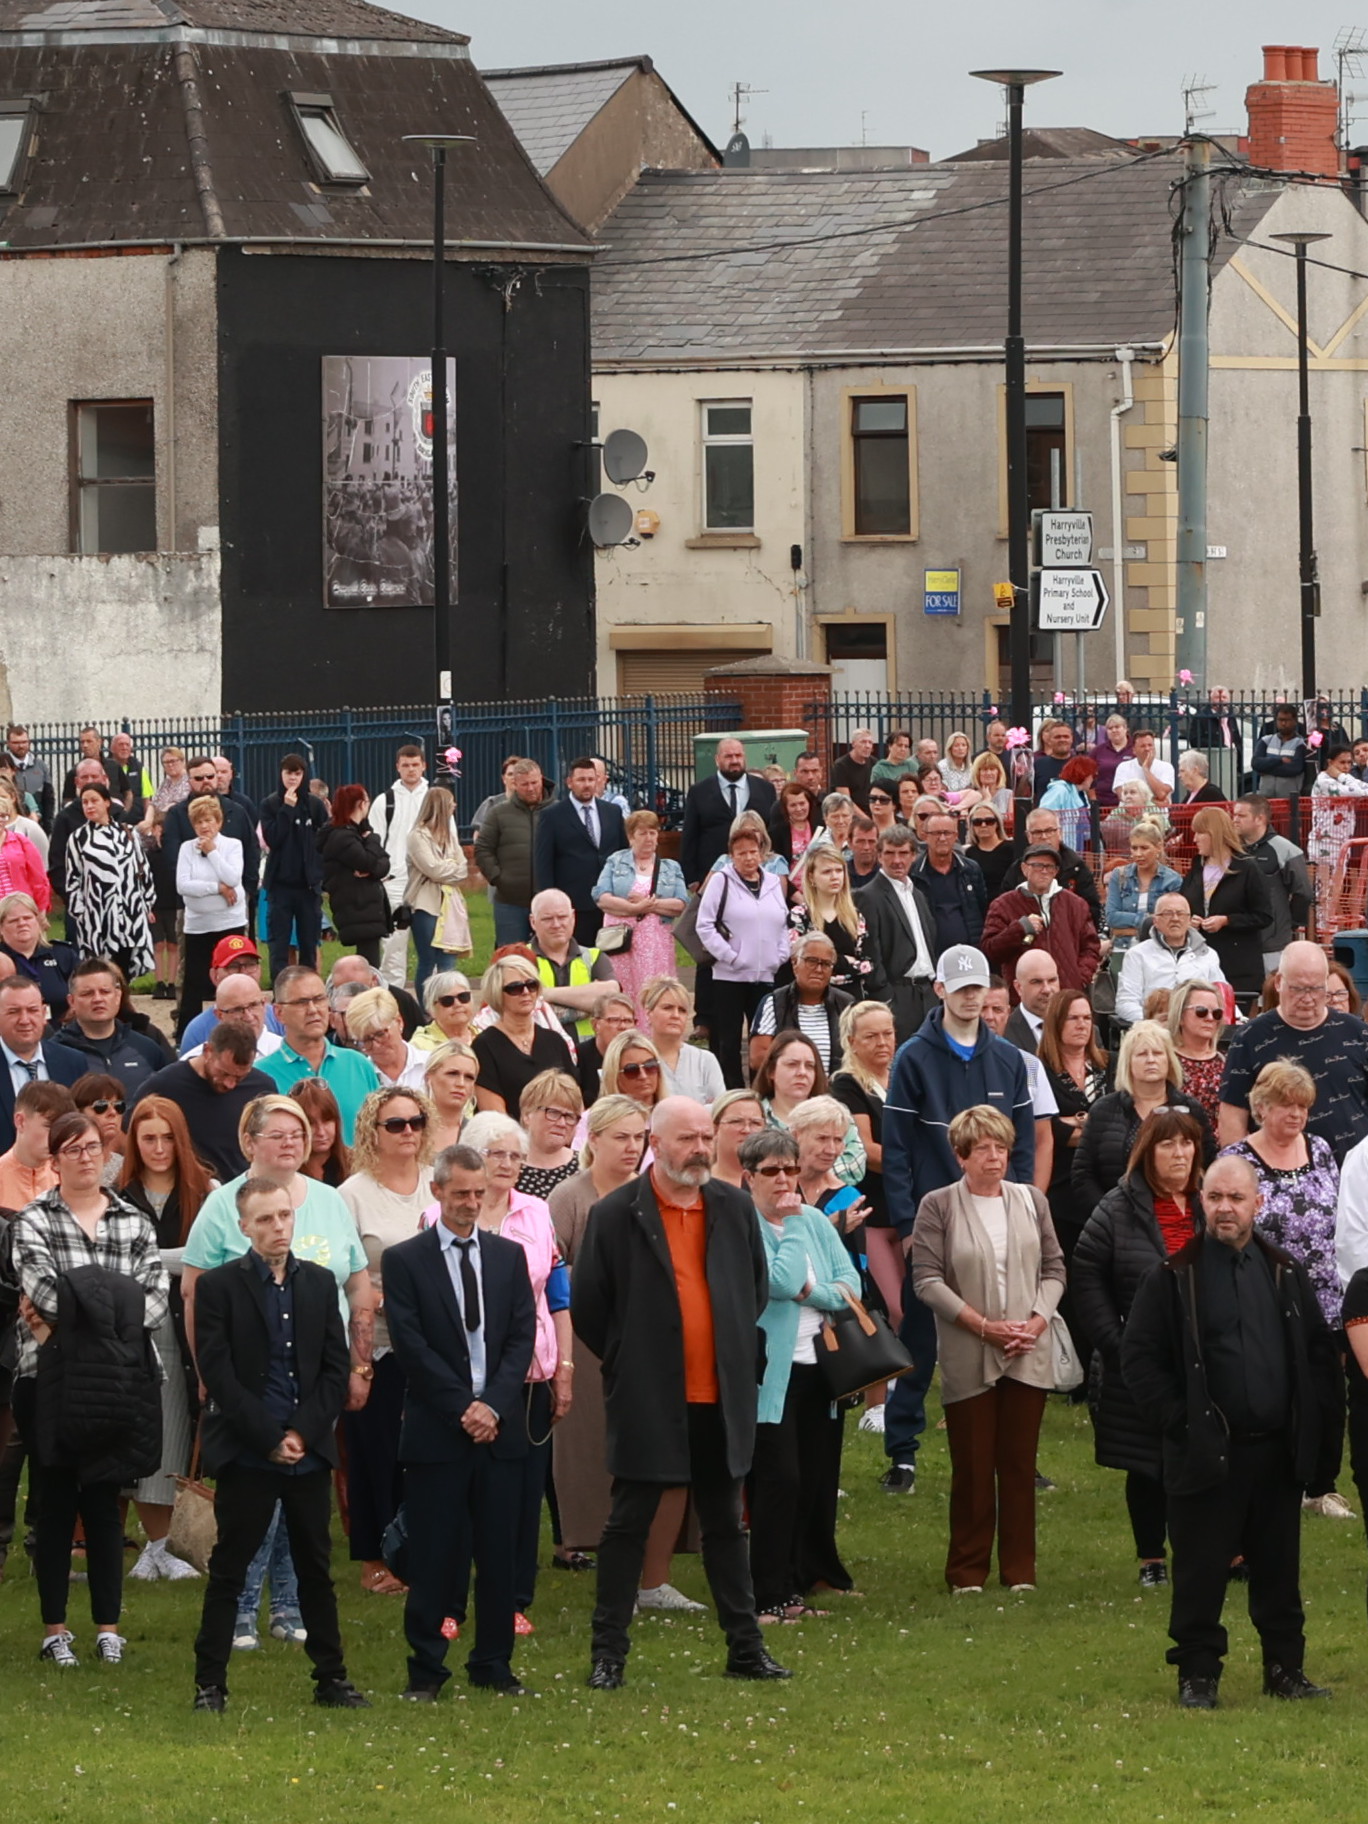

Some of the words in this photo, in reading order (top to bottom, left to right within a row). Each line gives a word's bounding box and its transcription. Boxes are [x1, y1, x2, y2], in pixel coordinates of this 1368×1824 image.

[1050, 518, 1086, 531] Harryville
[1045, 534, 1089, 547] Presbyterian
[1055, 548, 1083, 560] Church
[1052, 575, 1084, 586] Harryville
[1043, 587, 1070, 599] Primary
[1071, 587, 1094, 598] School
[925, 594, 941, 608] FOR
[942, 594, 957, 608] SALE
[1063, 601, 1075, 611] and
[1046, 613, 1074, 625] Nursery
[1076, 613, 1090, 624] Unit
